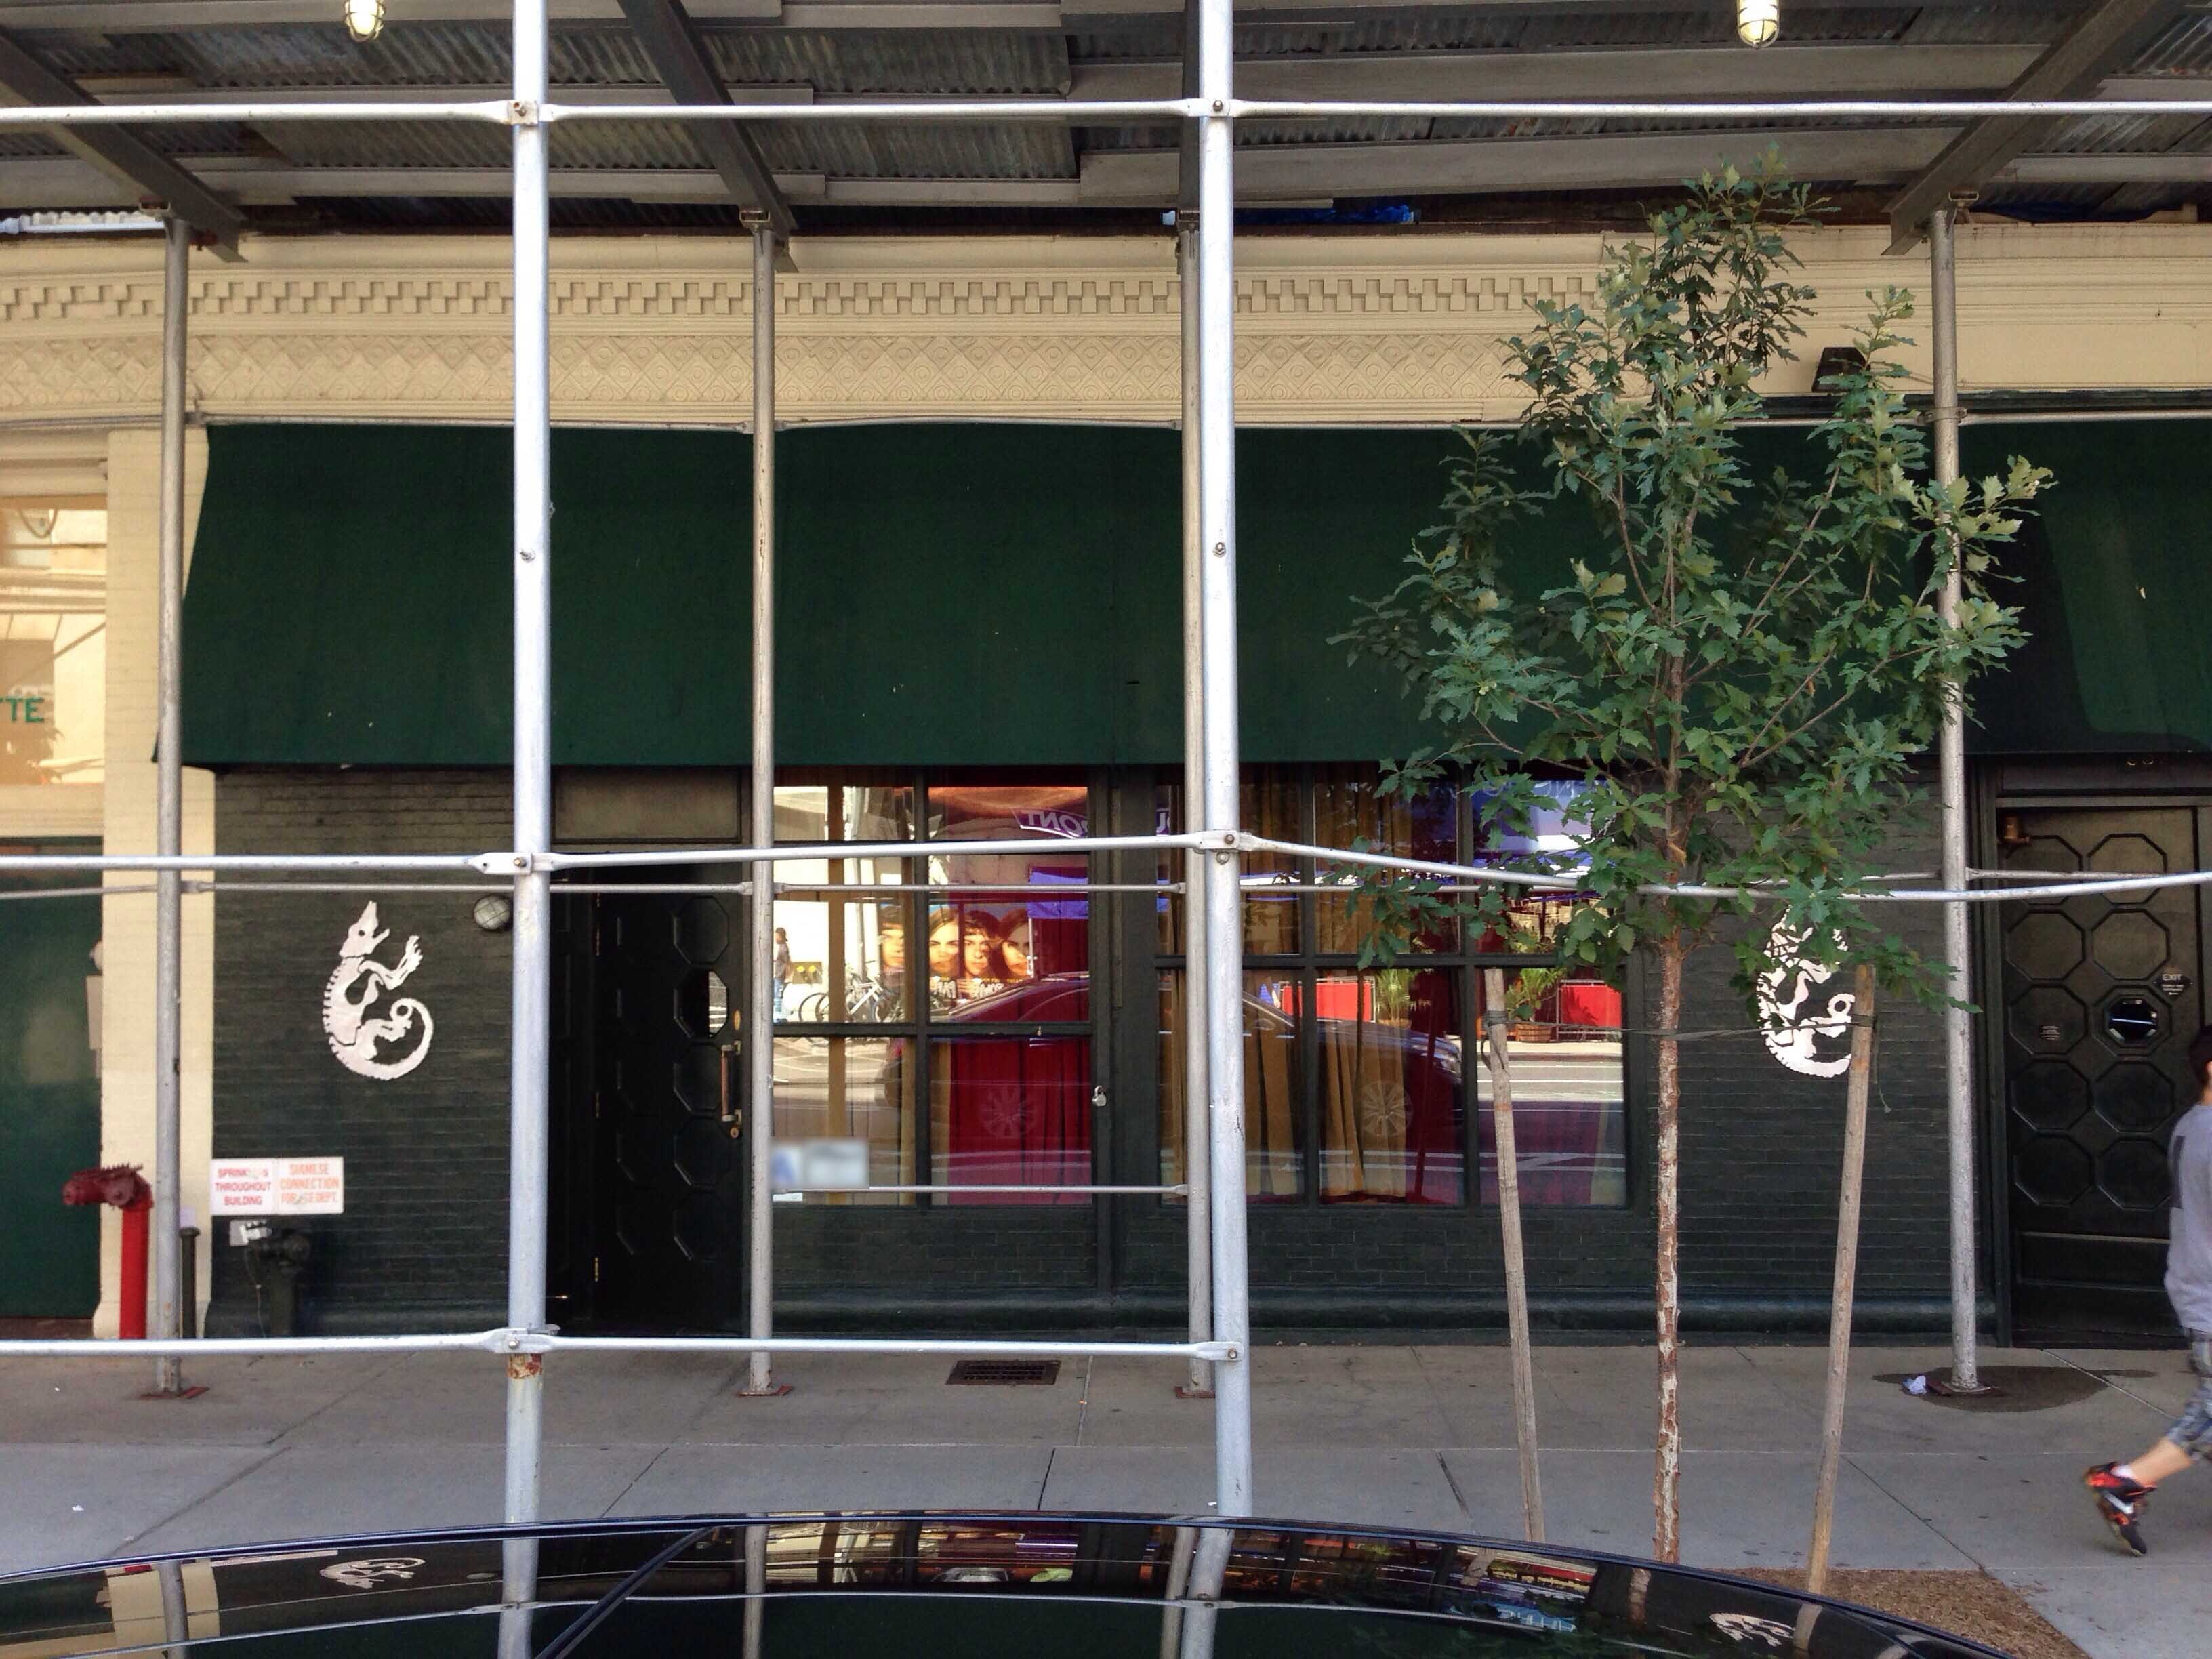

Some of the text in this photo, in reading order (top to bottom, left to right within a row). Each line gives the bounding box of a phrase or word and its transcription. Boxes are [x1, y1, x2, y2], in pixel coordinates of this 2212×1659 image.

[0, 696, 45, 723] TE
[2163, 973, 2183, 981] EXIT
[215, 1181, 272, 1193] THROUGHOUT
[281, 1177, 340, 1190] CONNECTION
[224, 1195, 263, 1206] BUILDING
